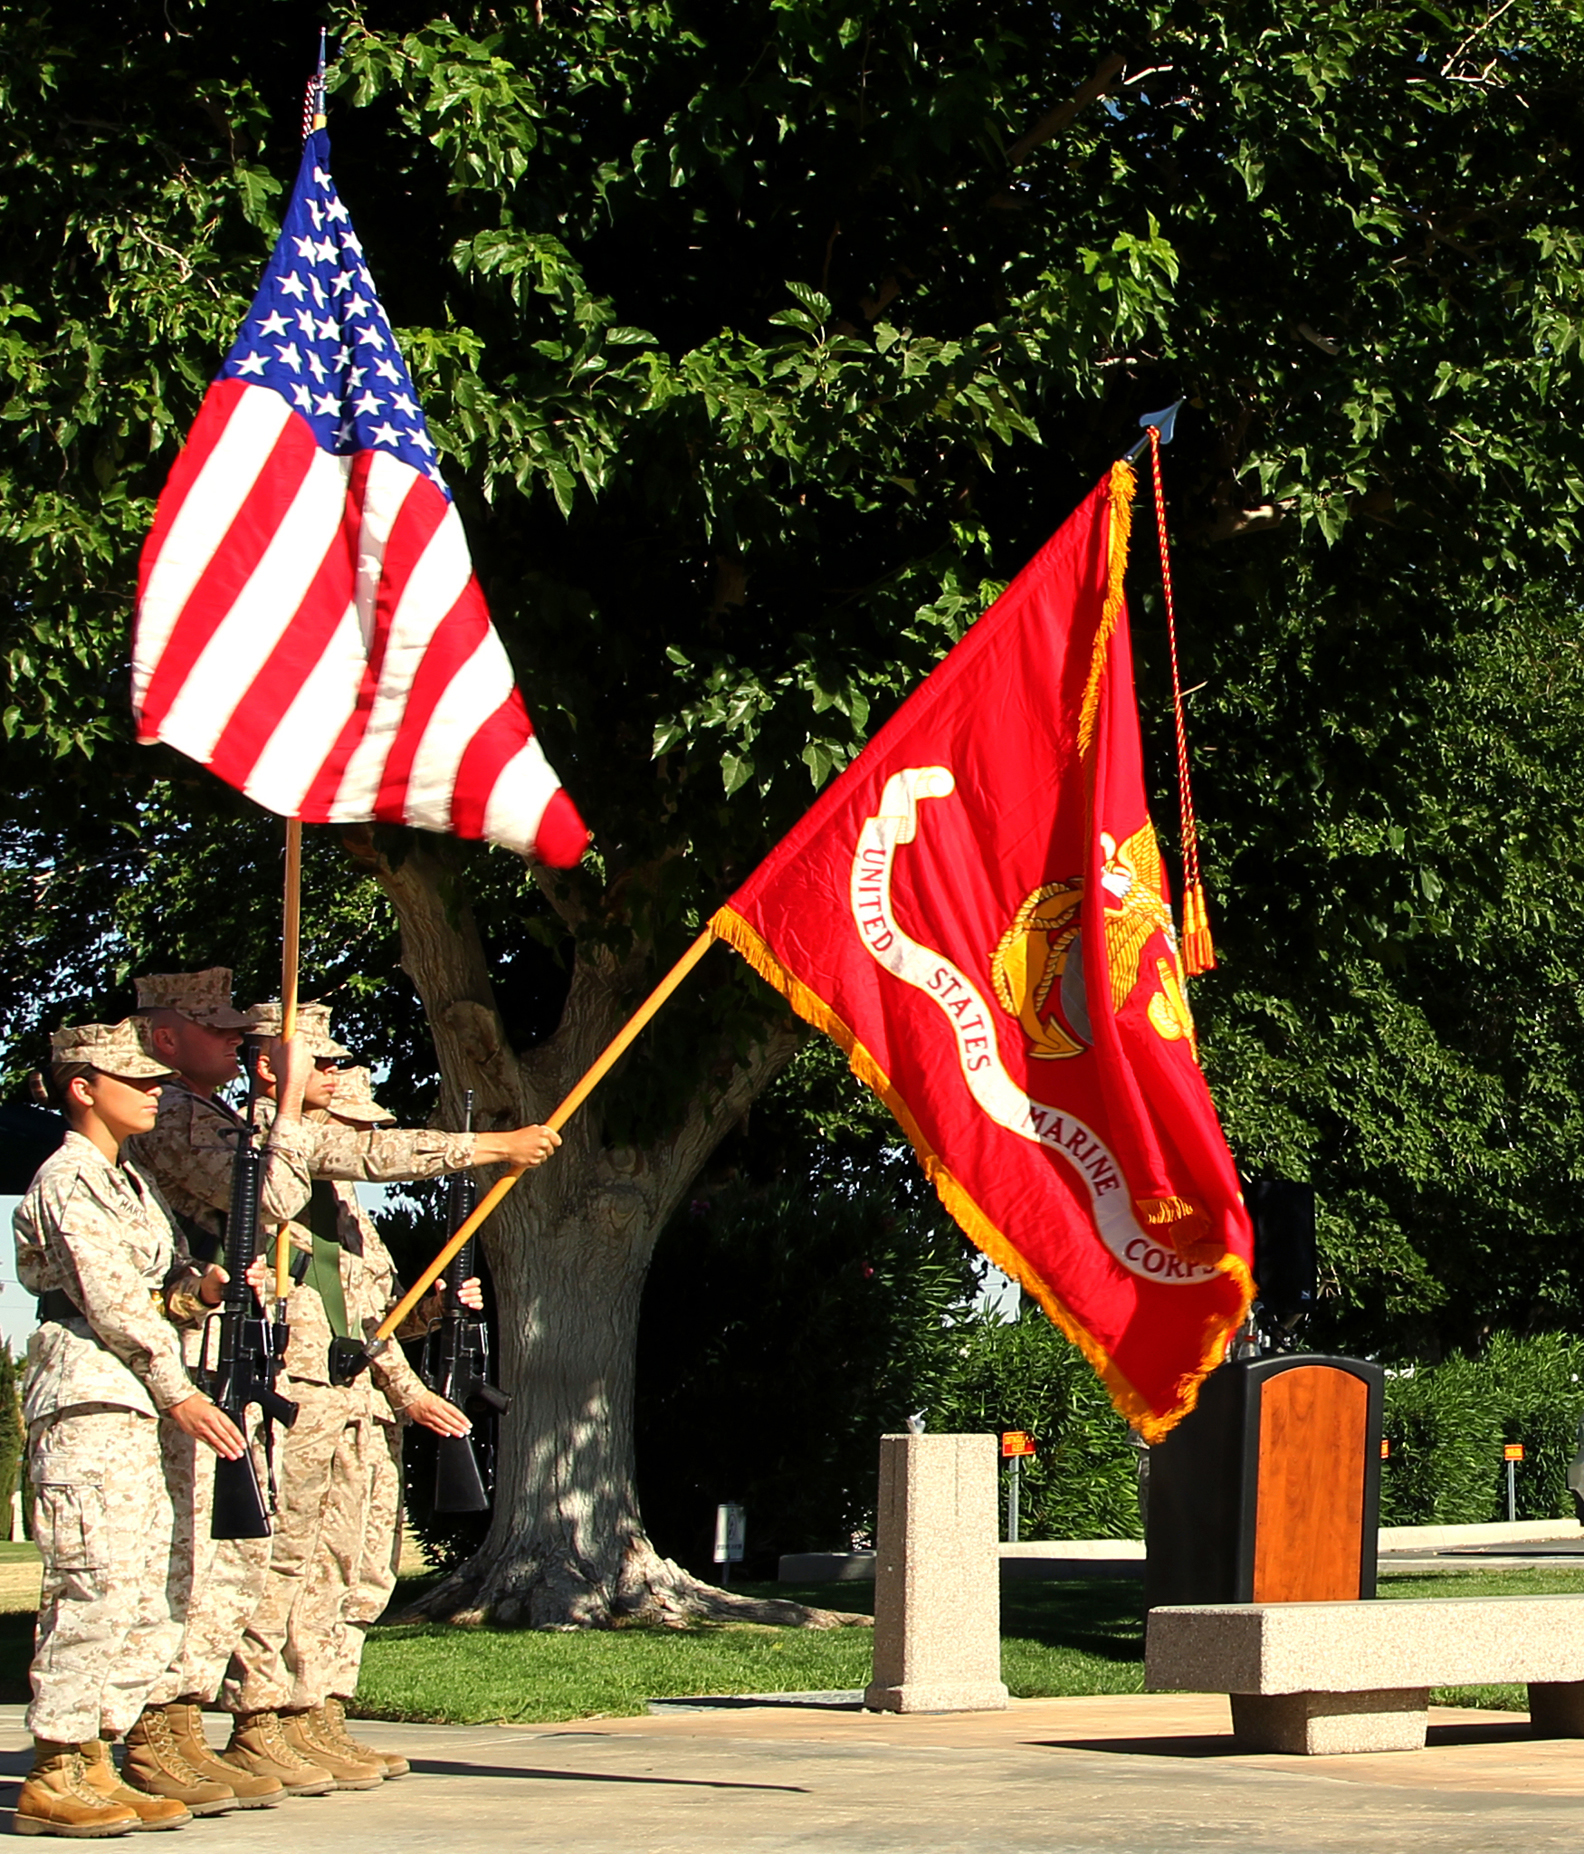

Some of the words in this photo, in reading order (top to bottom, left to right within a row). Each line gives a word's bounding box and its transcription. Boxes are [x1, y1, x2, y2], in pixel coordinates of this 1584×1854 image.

[858, 848, 894, 951] UNITED
[927, 967, 992, 1072] STATES
[1021, 1106, 1120, 1196] MARINE
